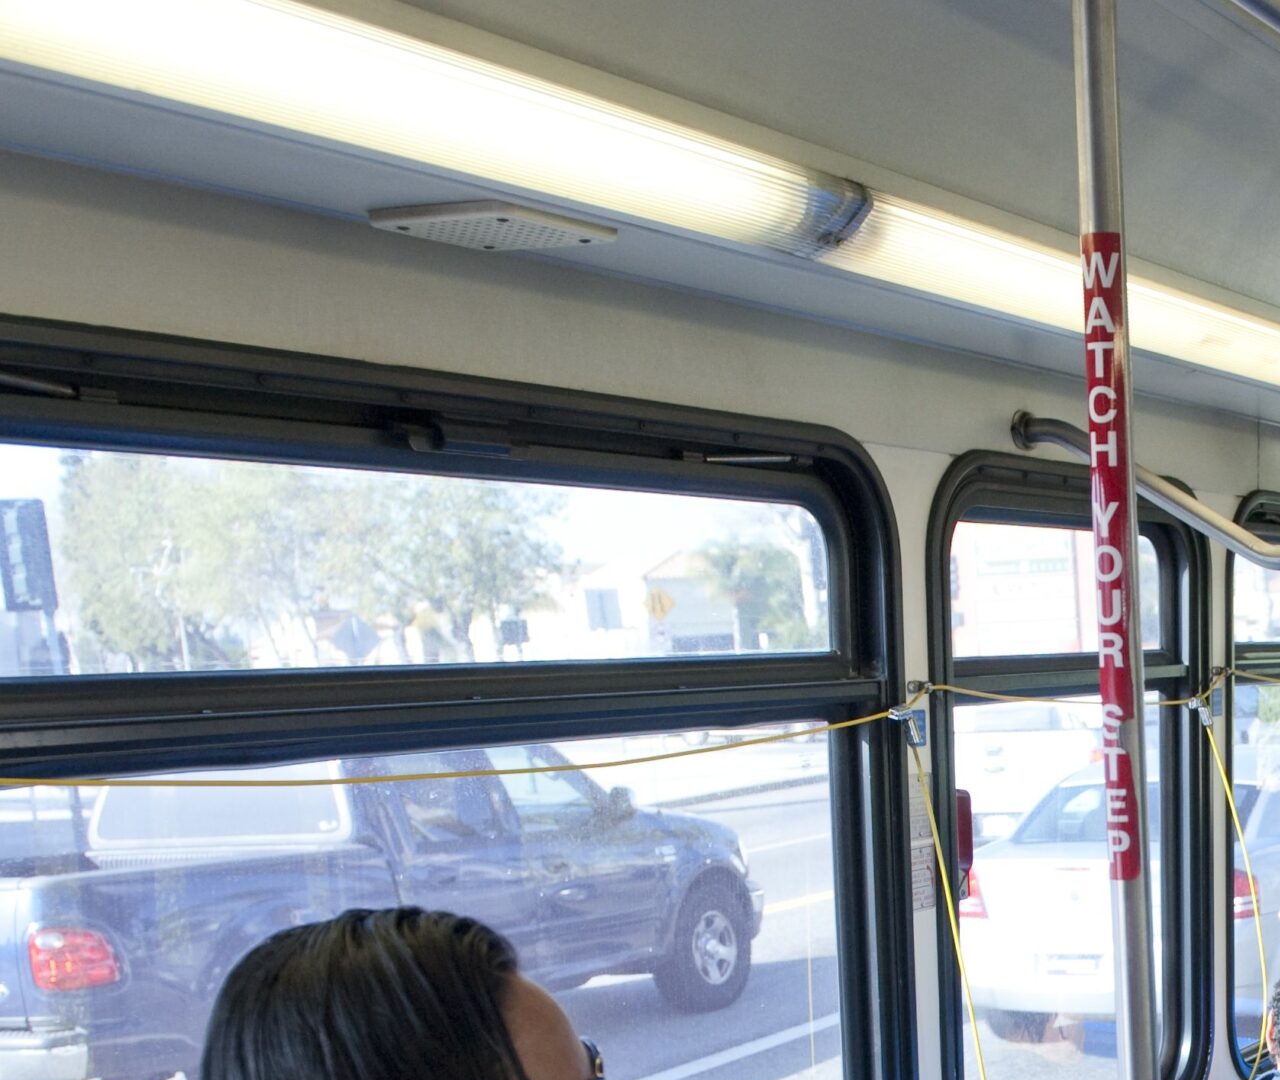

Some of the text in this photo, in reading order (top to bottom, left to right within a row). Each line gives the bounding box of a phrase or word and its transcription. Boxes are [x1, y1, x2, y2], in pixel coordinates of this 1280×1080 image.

[1082, 251, 1131, 864] WATCH YOUR STEP
